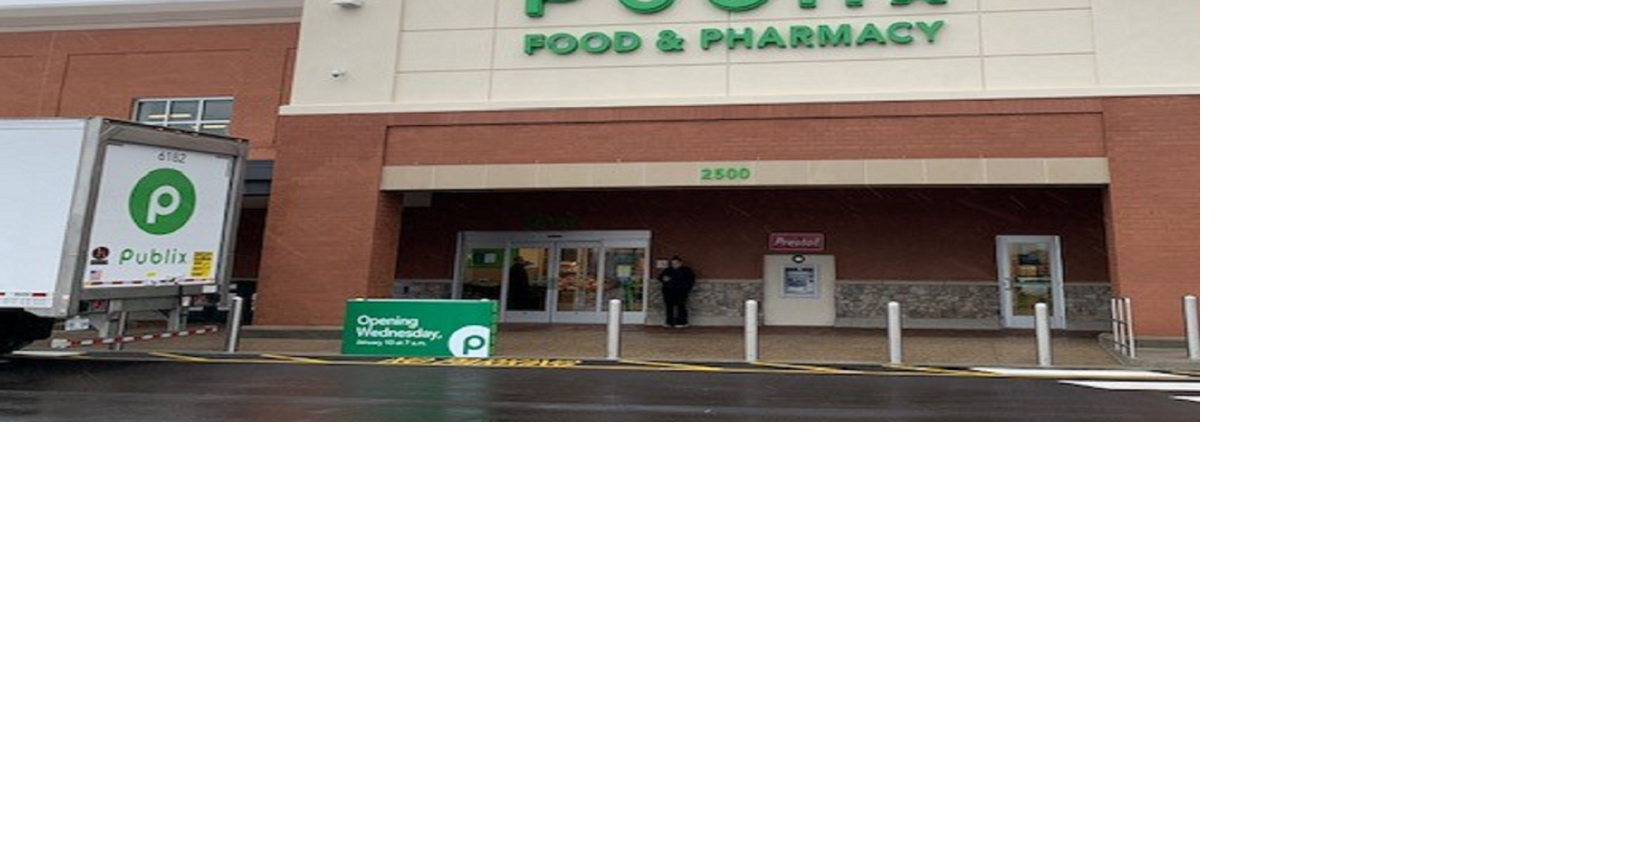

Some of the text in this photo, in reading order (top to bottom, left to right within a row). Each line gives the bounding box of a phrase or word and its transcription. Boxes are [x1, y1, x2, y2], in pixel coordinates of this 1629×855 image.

[523, 20, 945, 55] FOOD & PHARMACY
[157, 151, 187, 164] 6182
[701, 168, 751, 180] 2500
[119, 248, 188, 265] Publix
[357, 314, 419, 329] Opening
